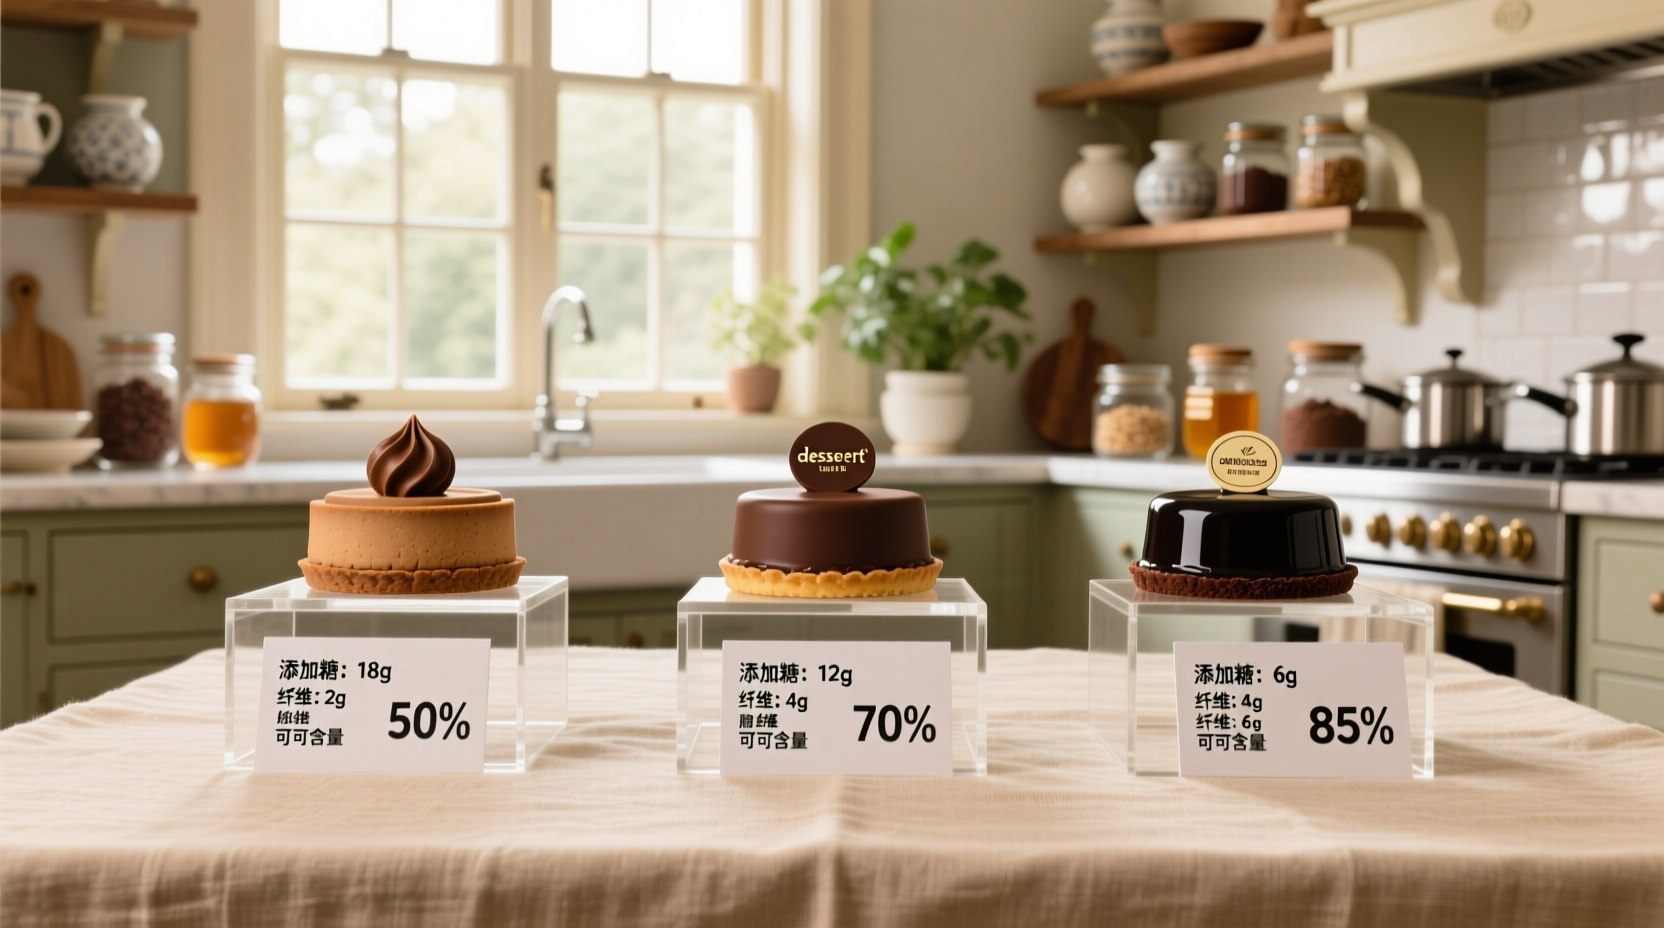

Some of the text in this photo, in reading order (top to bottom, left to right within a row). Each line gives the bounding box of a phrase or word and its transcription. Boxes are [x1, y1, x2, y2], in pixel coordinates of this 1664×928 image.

[358, 662, 391, 683] 18g
[819, 664, 852, 687] 12g
[1273, 665, 1297, 688] 6g
[325, 690, 346, 709] 2g
[786, 693, 807, 712] 4g
[1241, 694, 1262, 712] 4g
[388, 702, 470, 740] 50%
[854, 705, 936, 743] 70%
[1242, 715, 1261, 732] 6g
[1310, 706, 1394, 745] 85%
[276, 728, 343, 746] 可可含量
[739, 731, 807, 749] 可可含量
[1197, 732, 1266, 751] 可可含量
